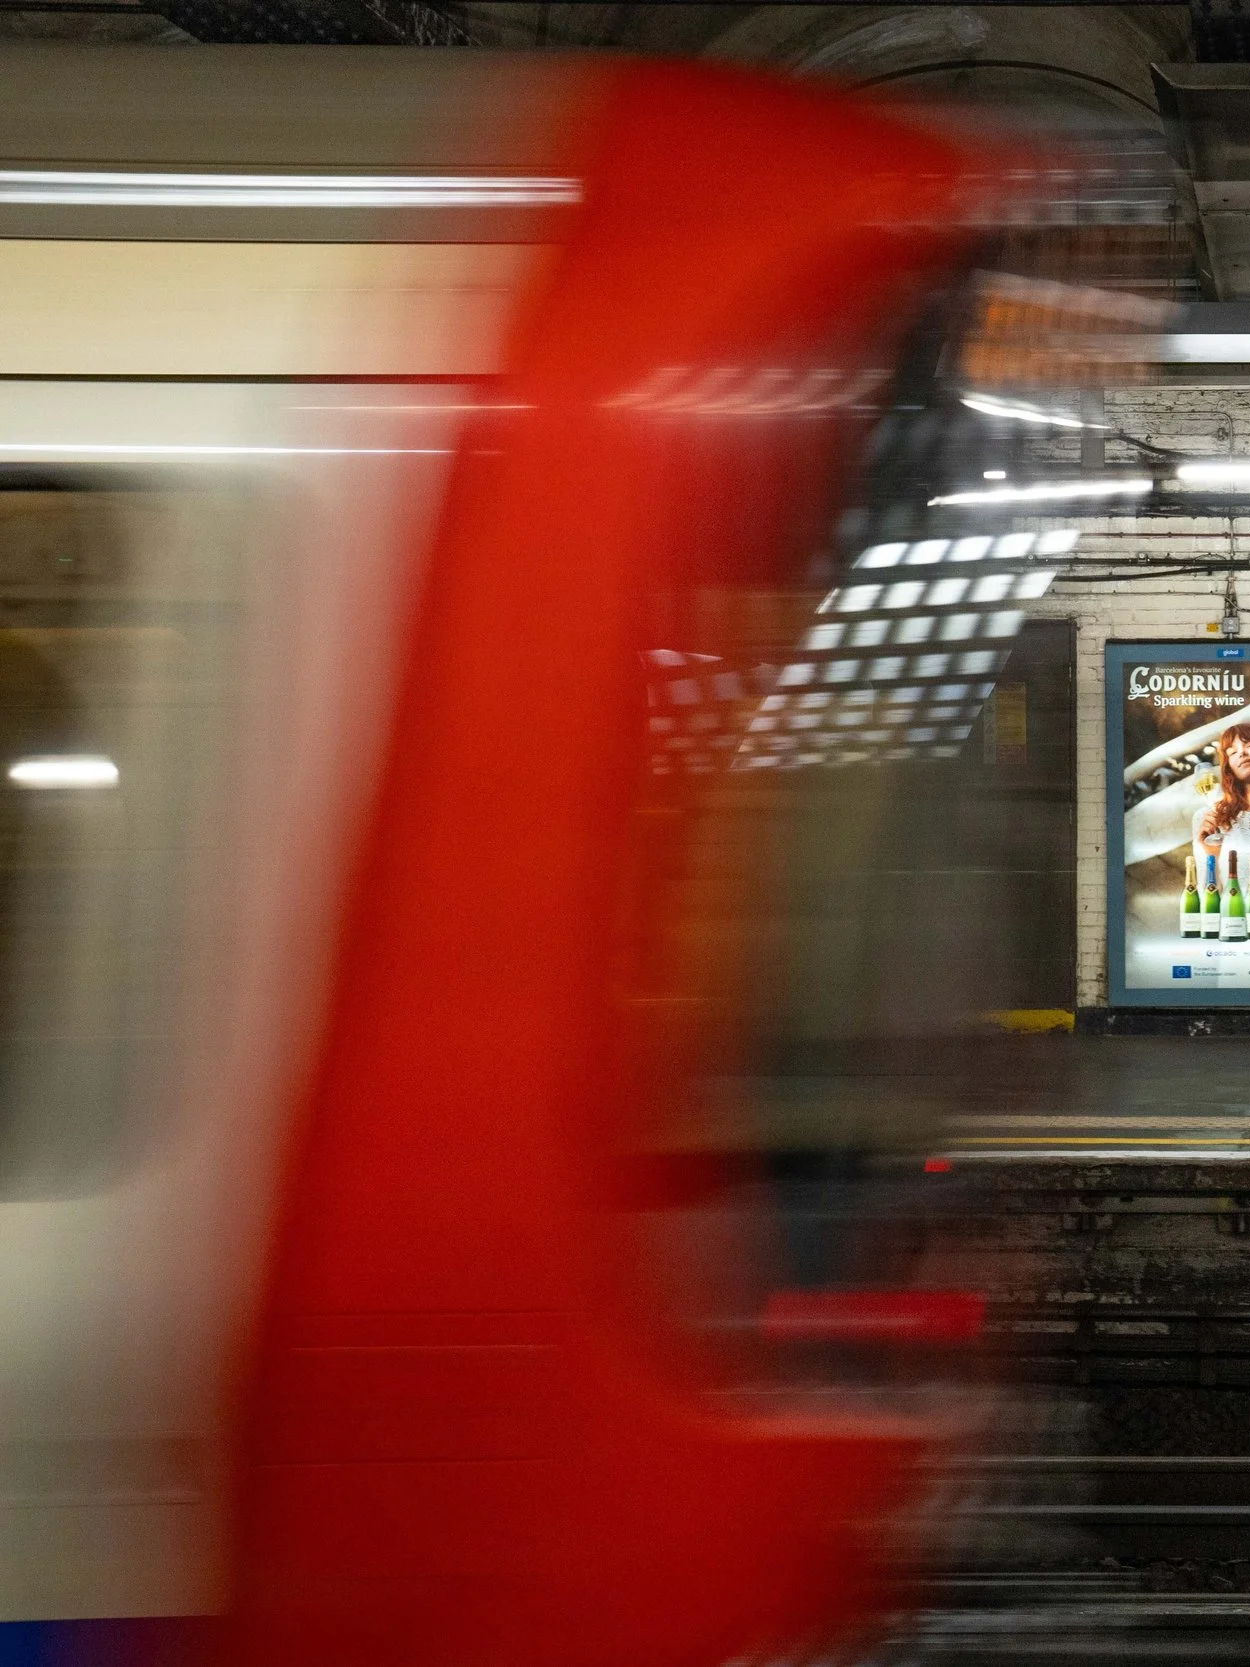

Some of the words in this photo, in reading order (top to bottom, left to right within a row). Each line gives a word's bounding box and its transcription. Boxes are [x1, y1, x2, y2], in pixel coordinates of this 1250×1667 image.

[1222, 649, 1239, 657] global
[1193, 666, 1221, 674] favourite
[1128, 666, 1244, 700] CODORNÍU
[1153, 694, 1212, 708] Sparkling
[1214, 695, 1245, 706] wine
